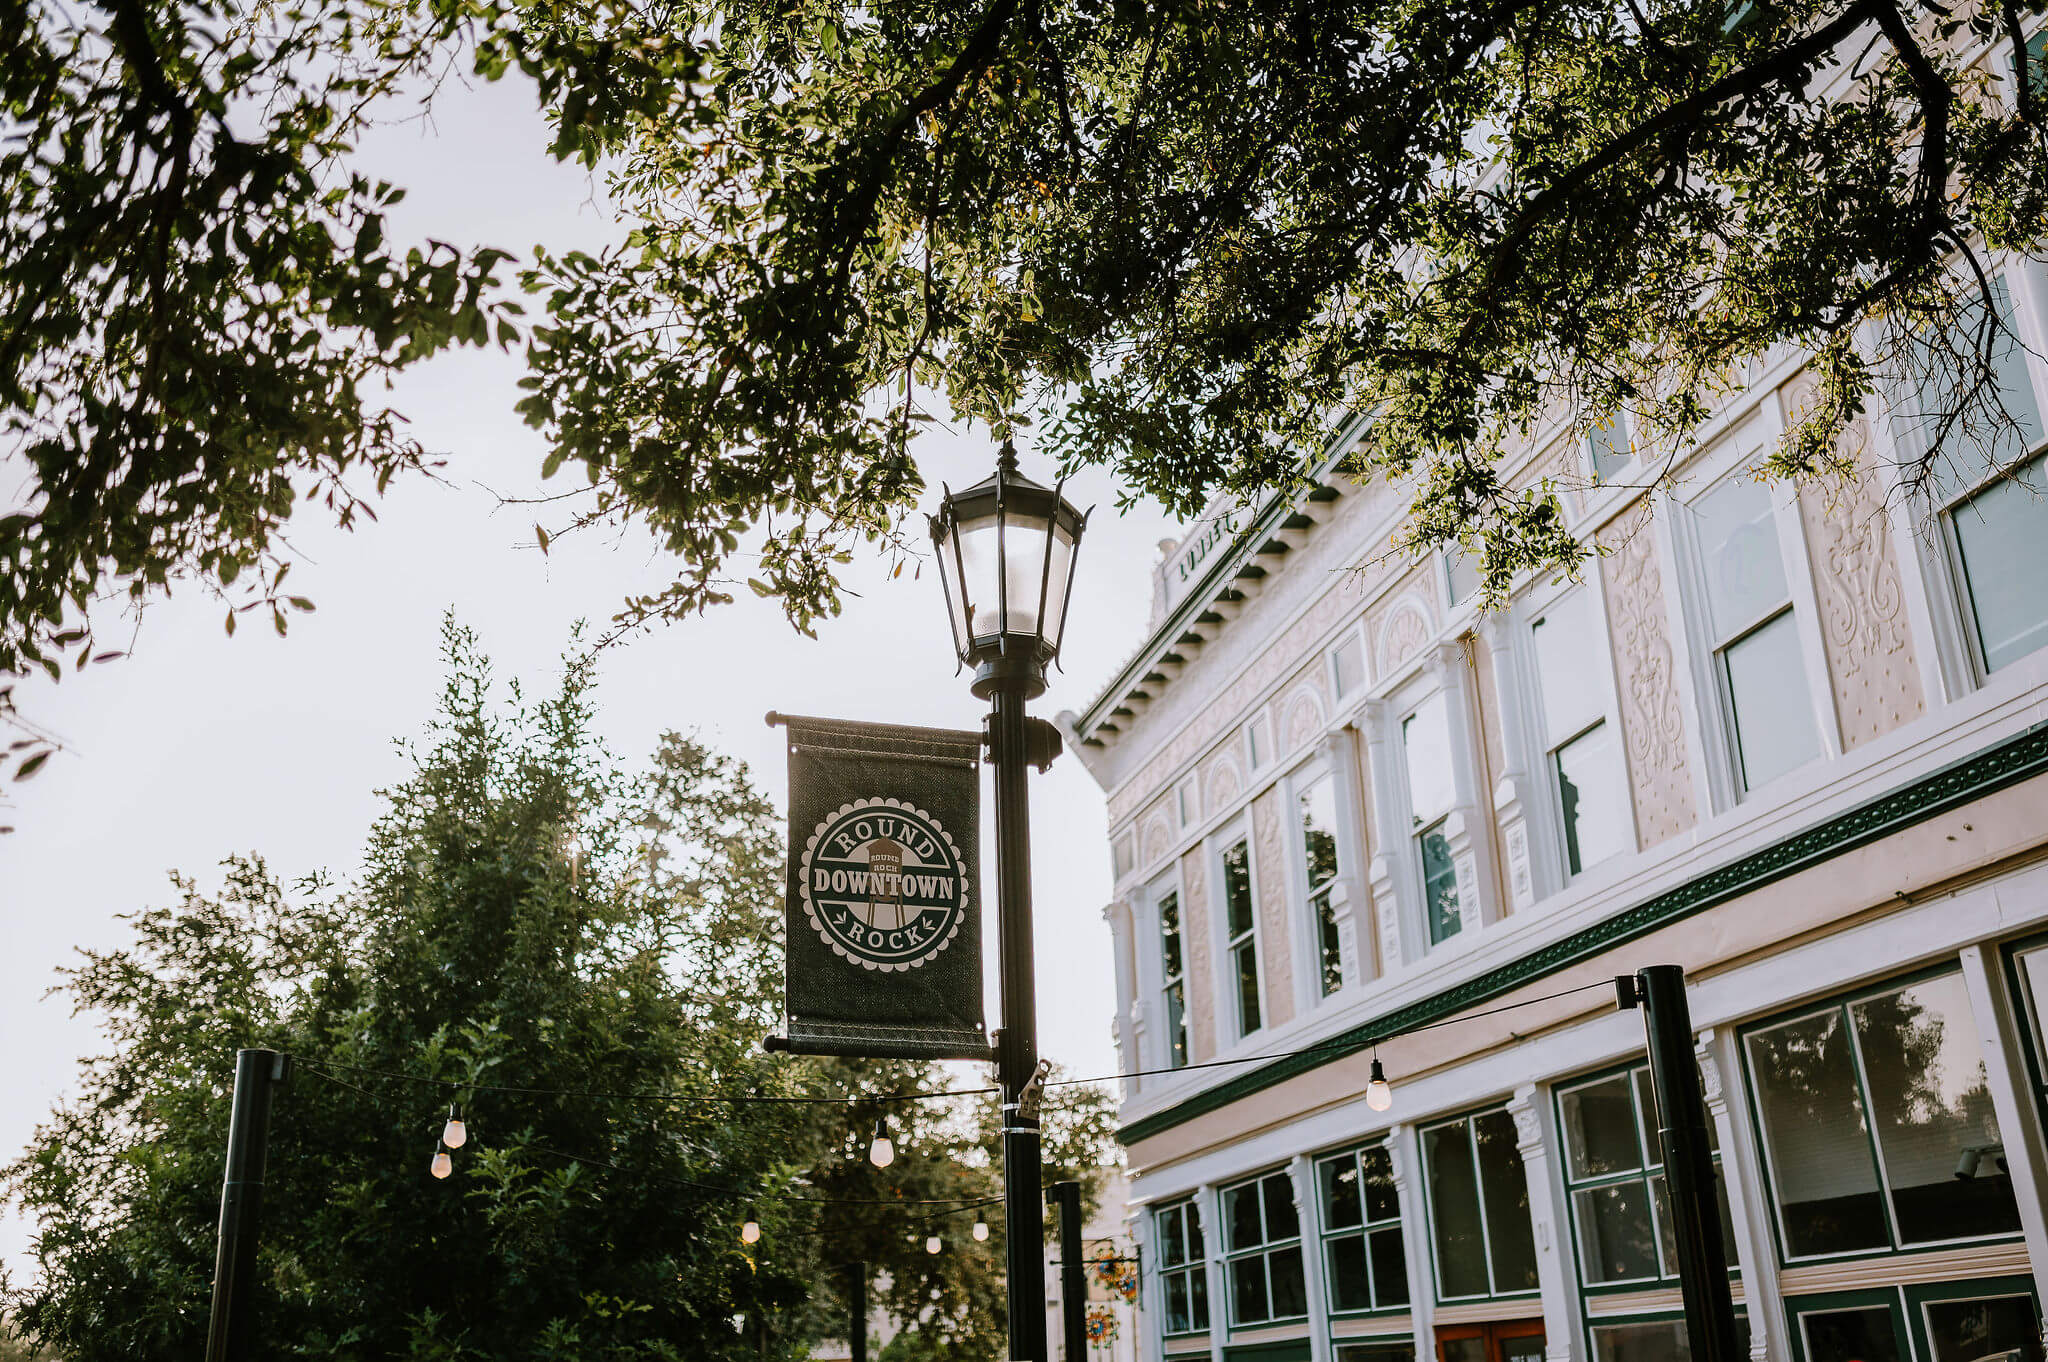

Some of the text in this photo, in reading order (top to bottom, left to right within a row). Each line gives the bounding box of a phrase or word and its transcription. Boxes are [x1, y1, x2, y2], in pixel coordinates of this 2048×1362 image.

[835, 818, 935, 858] ROUND
[870, 854, 900, 863] ROUND
[873, 864, 898, 873] ROCK
[814, 868, 954, 900] DOWNTOWN
[847, 921, 924, 950] ROCK
